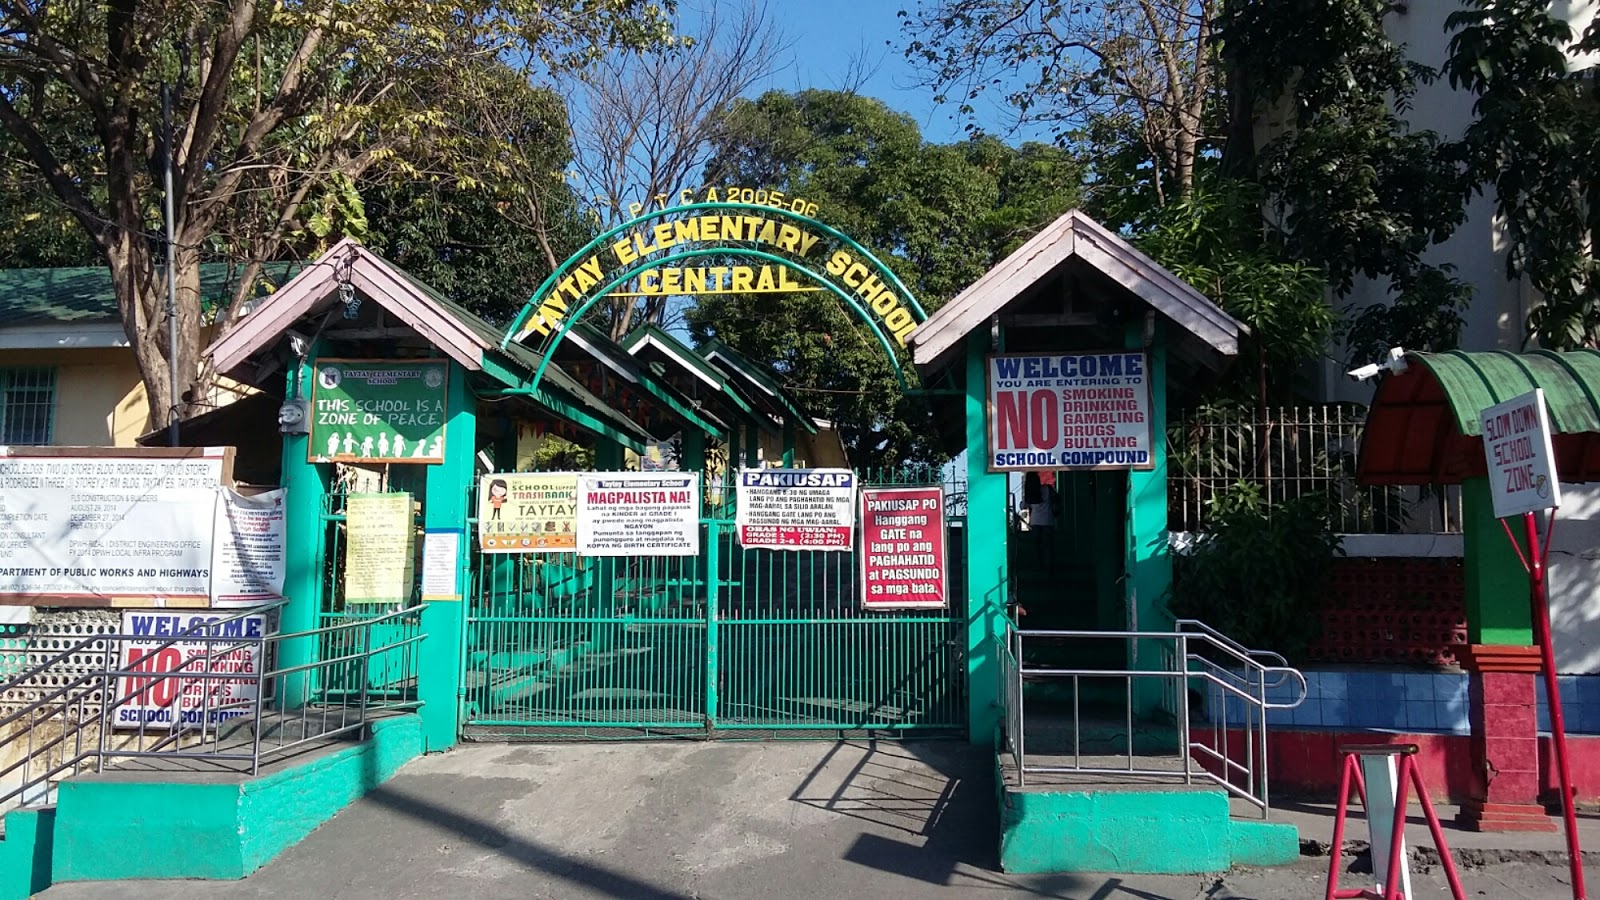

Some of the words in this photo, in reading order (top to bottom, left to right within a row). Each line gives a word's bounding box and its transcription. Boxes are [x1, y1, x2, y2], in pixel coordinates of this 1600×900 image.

[727, 187, 820, 219] 2005-06
[525, 255, 605, 337] TAYTAY
[612, 216, 820, 266] ELEMENTARY
[826, 251, 918, 349] SCHOOL
[640, 265, 798, 293] CENTRAL
[996, 355, 1143, 379] WELCOME
[997, 380, 1022, 388] YOU
[1027, 379, 1051, 387] ARE
[1056, 378, 1120, 387] ENTERING
[1125, 377, 1142, 385] TO
[1063, 388, 1135, 400] SMOKING
[317, 399, 350, 412] THIS
[356, 400, 411, 412] SCHOOL
[416, 400, 429, 412] IS
[434, 400, 444, 412] A
[1063, 400, 1137, 412] DRINKING
[318, 412, 358, 425] ZONE
[363, 412, 382, 425] OF
[388, 412, 440, 425] PEACE.
[996, 389, 1059, 450] NO
[1063, 412, 1144, 424] GAMBLING
[1486, 412, 1512, 441] SLOW
[1511, 403, 1539, 434] DOWN
[1064, 425, 1116, 436] DRUGS
[1064, 437, 1137, 449] BULLYING
[1493, 435, 1536, 466] SCHOOL
[996, 452, 1056, 466] SCHOOL
[1061, 451, 1148, 464] COMPOUND
[47, 464, 60, 475] TWO
[70, 463, 96, 475] STOREY
[117, 464, 155, 475] RODRIGUEZ
[185, 464, 211, 475] STOREY
[5, 477, 39, 489] RODRIGUEZ
[45, 477, 65, 489] THREE
[75, 477, 100, 489] STOREY
[143, 477, 165, 489] TAYTAY
[602, 480, 622, 489] Taytay
[624, 480, 658, 488] Elementary
[661, 480, 684, 488] School
[746, 473, 850, 487] PAKIUSAP
[1503, 464, 1536, 494] ZONE
[71, 494, 81, 502] FLS
[82, 494, 125, 502] CONSTRUCTION
[131, 494, 158, 502] BUILDERS
[587, 491, 667, 504] MAGPALISTA
[669, 491, 691, 503] NA!
[71, 504, 94, 512] AUGUST
[104, 504, 117, 512] 2014
[519, 504, 577, 516] TAYTAY
[662, 504, 691, 512] papasok
[868, 500, 920, 511] PAKIUSAP
[922, 499, 937, 510] PO
[34, 513, 48, 521] DATE
[70, 513, 101, 521] DECEMBER
[112, 513, 126, 521] 2014
[875, 515, 927, 526] Hanggang
[10, 532, 46, 540] CONSULTANT
[636, 530, 672, 538] tanggapan
[880, 529, 907, 540] GATE
[909, 530, 923, 539] na
[7, 541, 28, 549] OFFICE
[138, 541, 179, 549] ENGINEERING
[180, 541, 201, 549] OFFICE
[871, 542, 893, 553] lang
[897, 543, 910, 553] po
[913, 542, 932, 553] ang
[77, 549, 91, 557] 2014
[92, 549, 111, 557] DPWH
[111, 549, 132, 557] LOCAL
[133, 549, 151, 557] INFRA
[152, 549, 183, 557] PROGRAM
[869, 555, 935, 566] PAGHAHATID
[50, 568, 61, 577] OF
[64, 568, 97, 577] PUBLIC
[100, 568, 134, 577] WORKS
[137, 568, 157, 577] AND
[159, 568, 209, 578] HIGHWAYS
[869, 570, 879, 580] at
[882, 569, 939, 580] PAGSUNDO
[156, 585, 173, 593] about
[174, 585, 184, 593] this
[871, 585, 883, 594] sa
[886, 585, 909, 595] mga
[912, 583, 938, 594] bata.
[131, 616, 262, 638] WELCOME
[122, 648, 182, 707] NO
